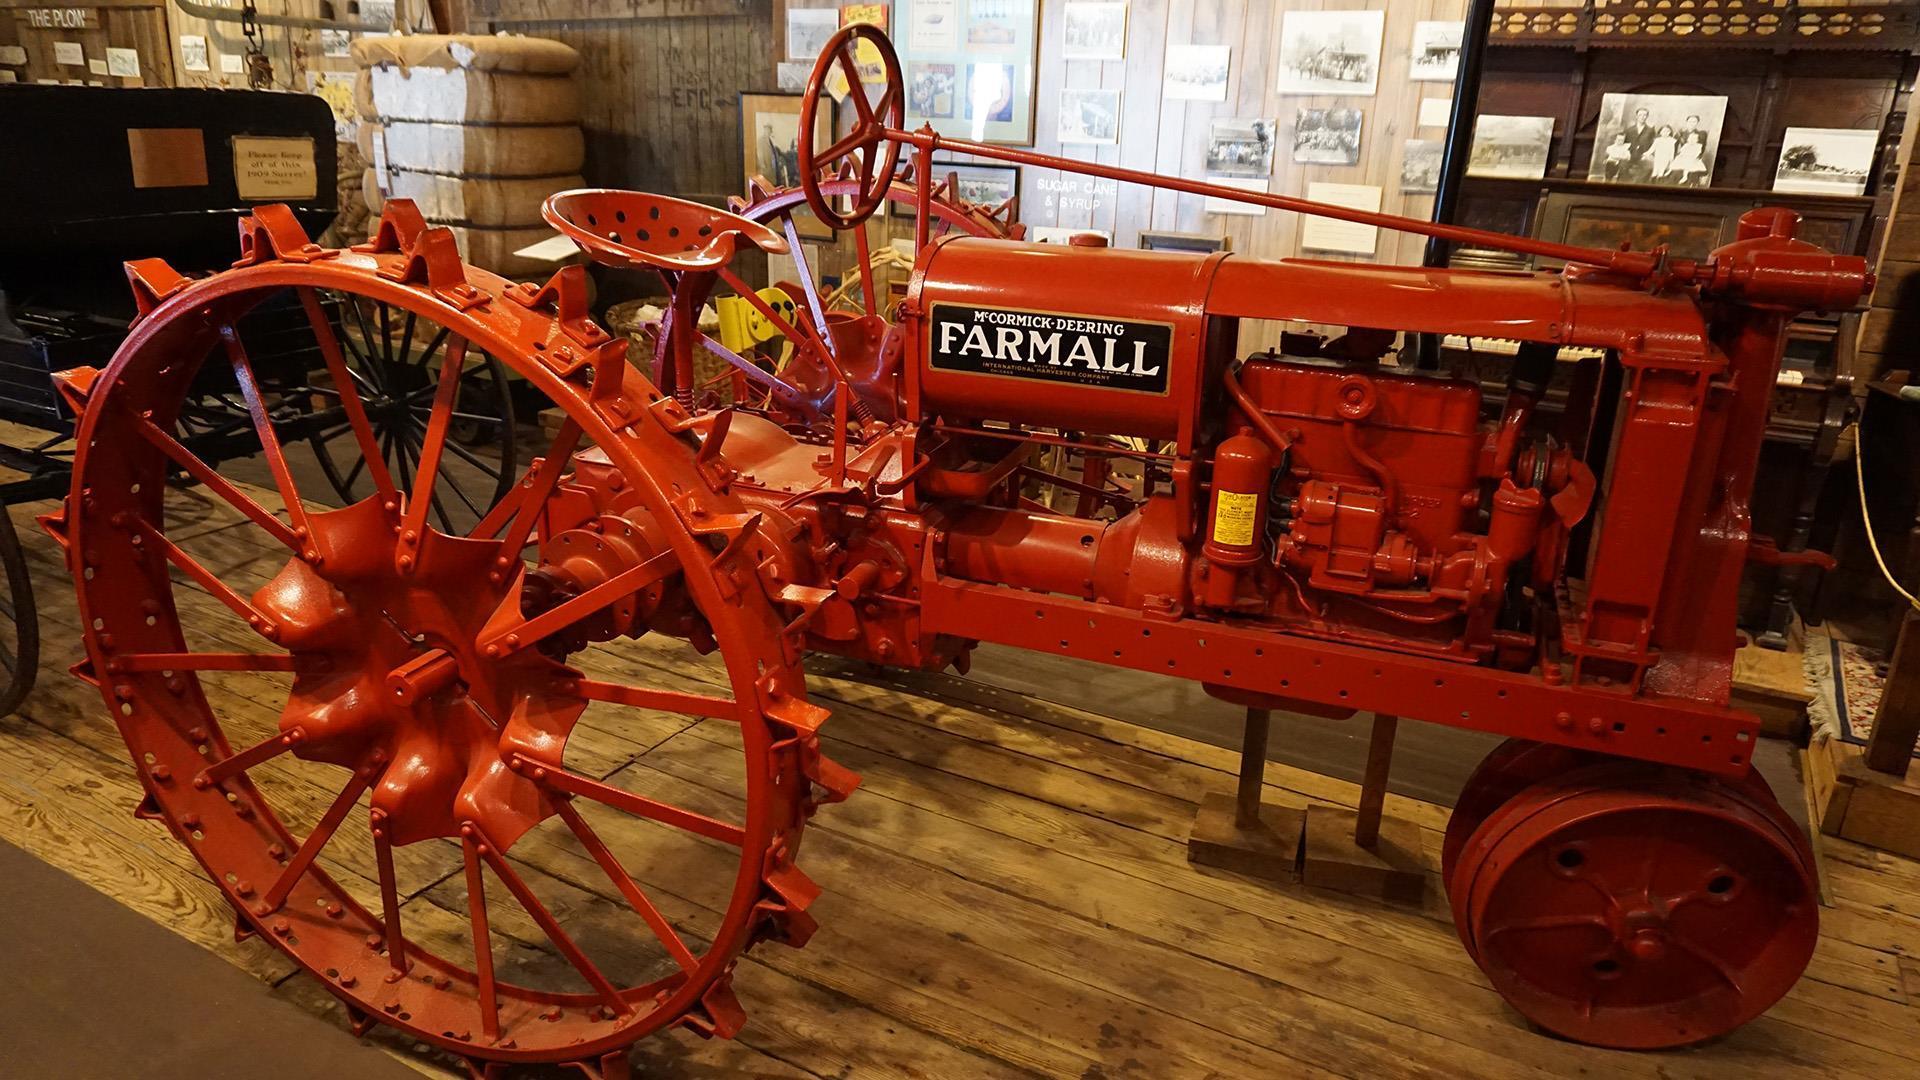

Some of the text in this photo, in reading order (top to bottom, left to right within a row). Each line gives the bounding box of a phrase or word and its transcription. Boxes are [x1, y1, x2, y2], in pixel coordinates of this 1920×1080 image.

[27, 8, 86, 28] THE PLOW
[1037, 179, 1117, 195] SUGAR CANE
[1044, 195, 1101, 210] & SYRUP
[938, 321, 1160, 376] FARMALL
[982, 361, 1035, 373] INTERNATIONAL
[1036, 367, 1076, 377] HARVESTER
[1078, 372, 1110, 380] COMPANY
